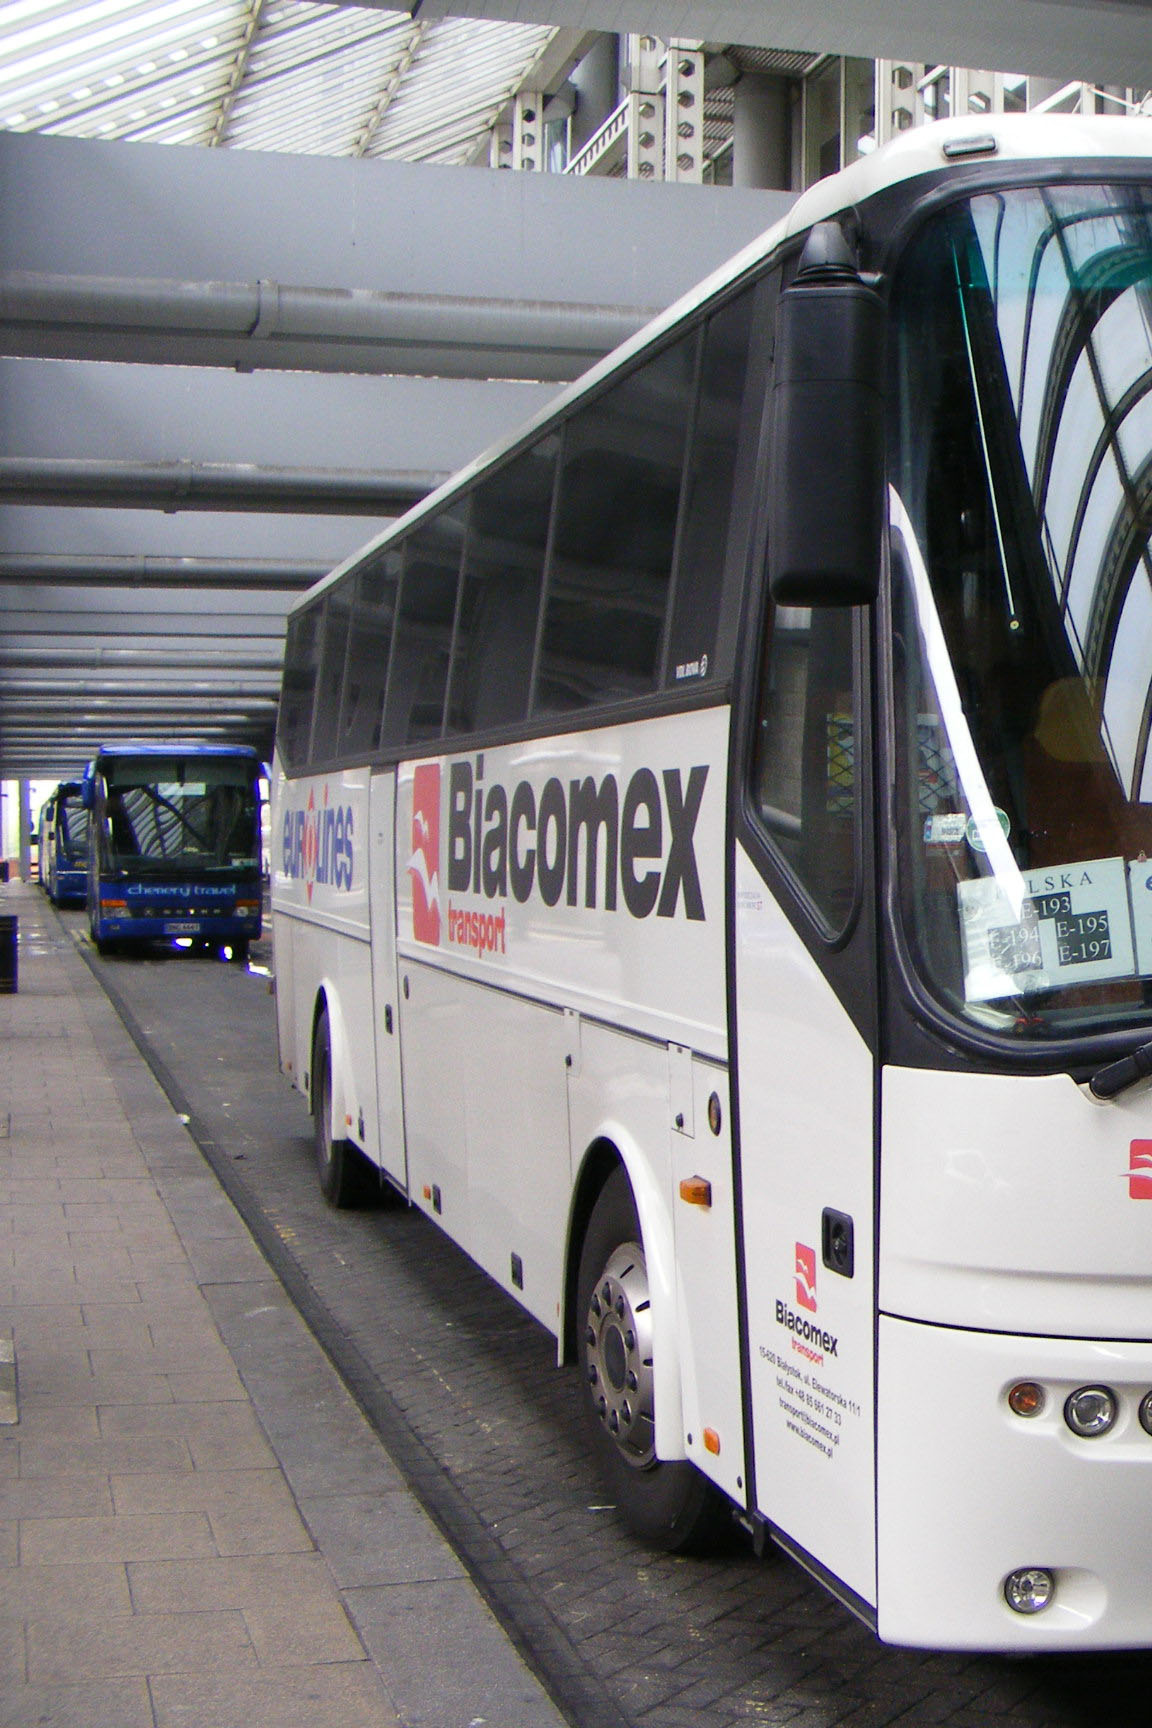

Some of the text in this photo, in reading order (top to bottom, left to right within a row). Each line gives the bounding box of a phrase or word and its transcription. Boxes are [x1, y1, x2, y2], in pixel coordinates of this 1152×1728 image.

[448, 753, 710, 921] Biacomex
[194, 884, 237, 896] travel
[1027, 871, 1093, 895] LSKA
[1021, 896, 1071, 920] E-193
[448, 898, 506, 958] transport
[1057, 915, 1108, 939] E-195
[1059, 940, 1111, 963] E-197
[775, 1299, 839, 1358] Biacomex
[791, 1335, 824, 1368] transport
